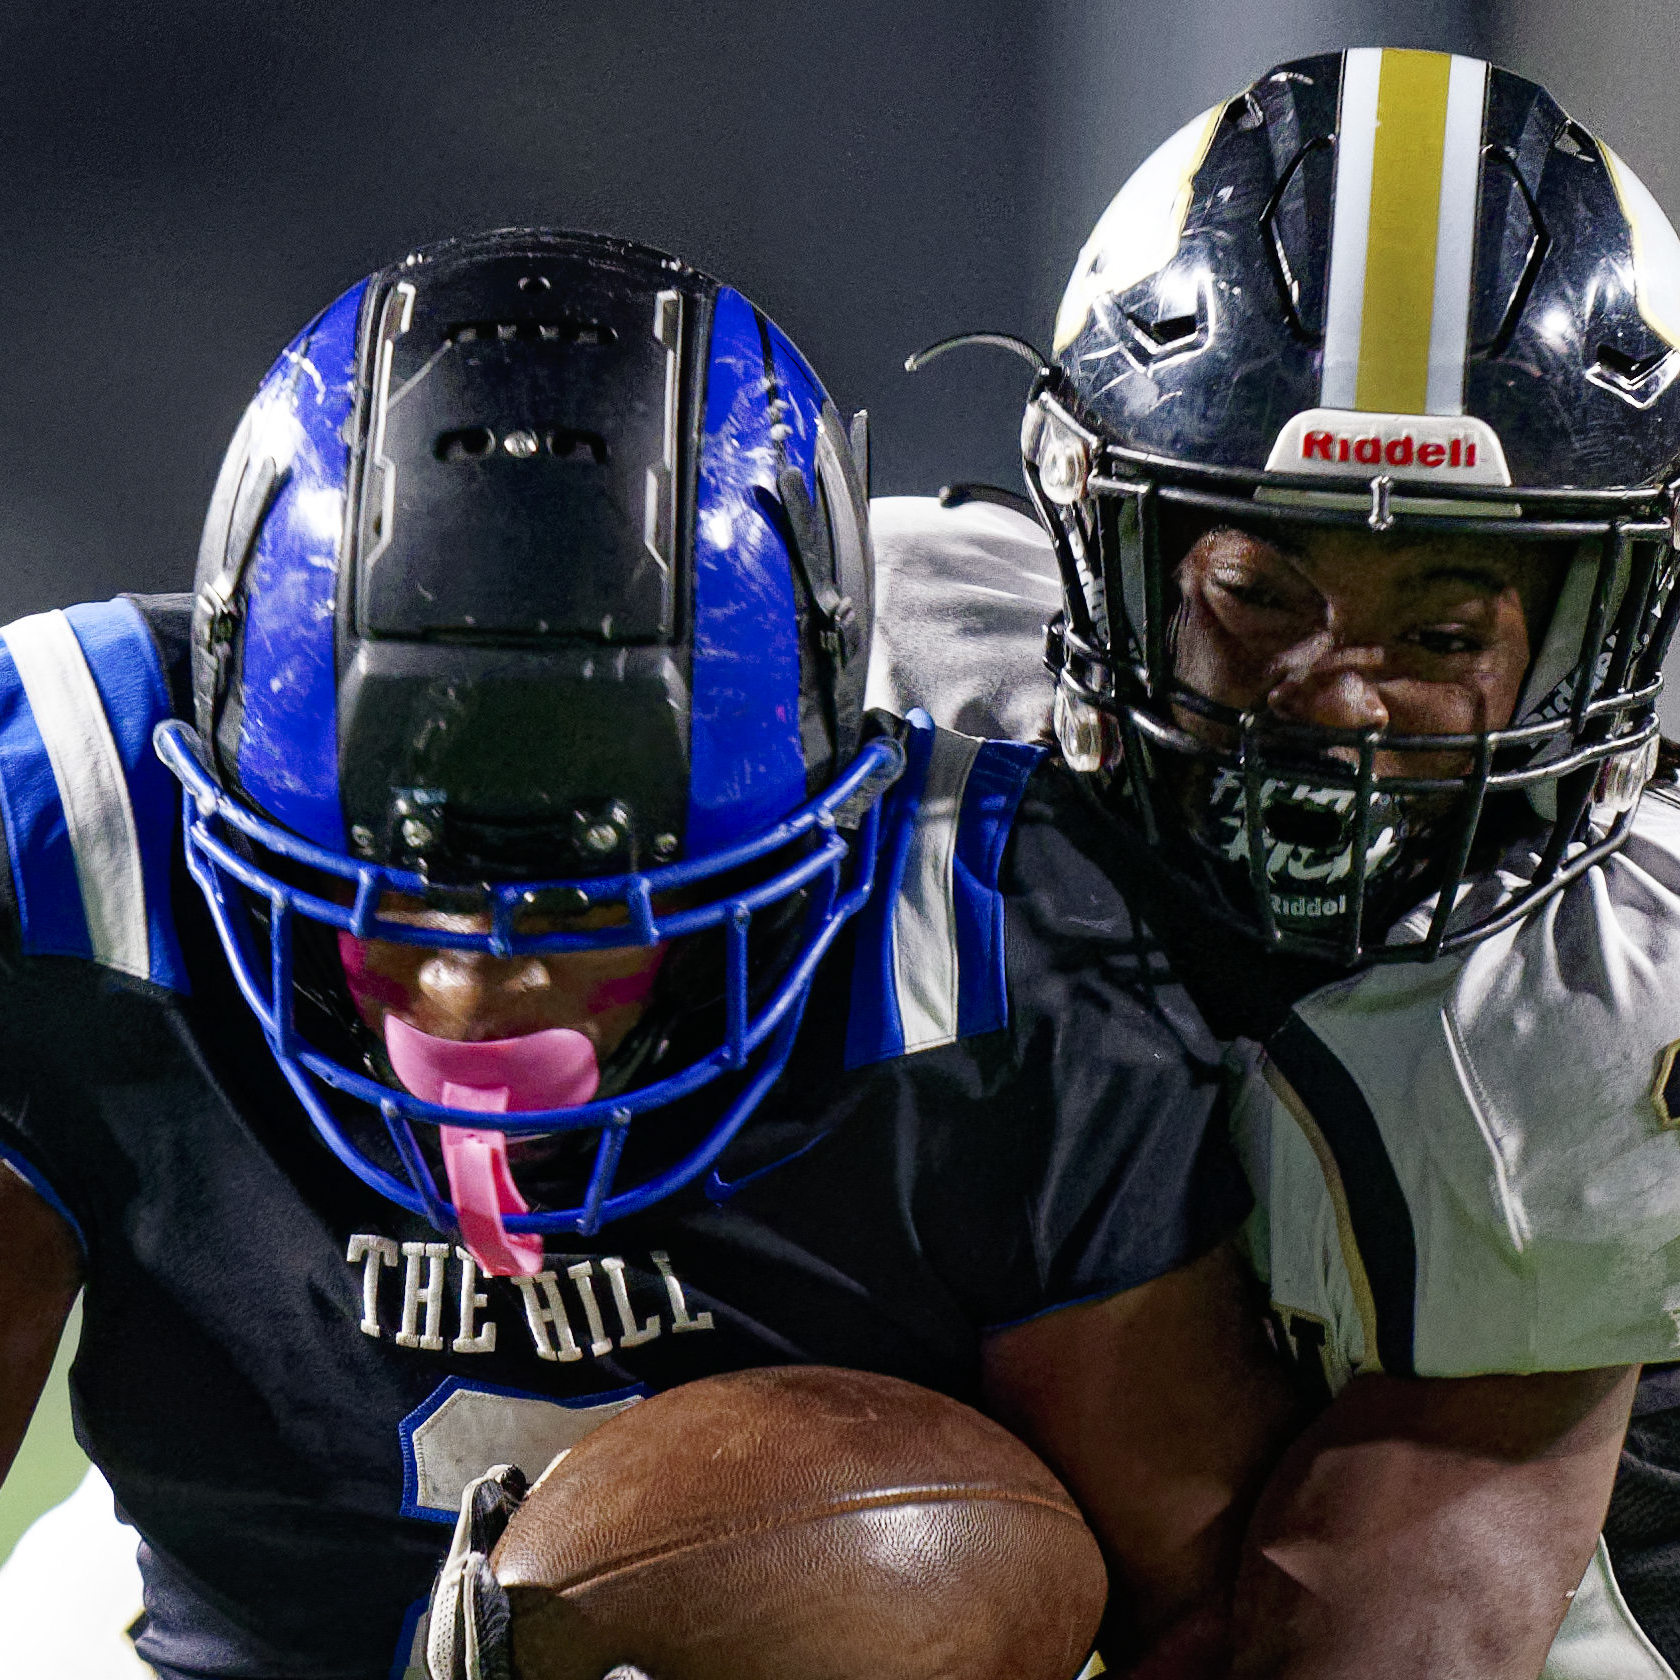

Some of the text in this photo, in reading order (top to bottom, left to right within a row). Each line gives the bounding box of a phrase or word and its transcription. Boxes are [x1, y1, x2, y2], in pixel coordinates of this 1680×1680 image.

[1301, 430, 1478, 468] Riddell
[346, 1234, 715, 1362] THE HILL
